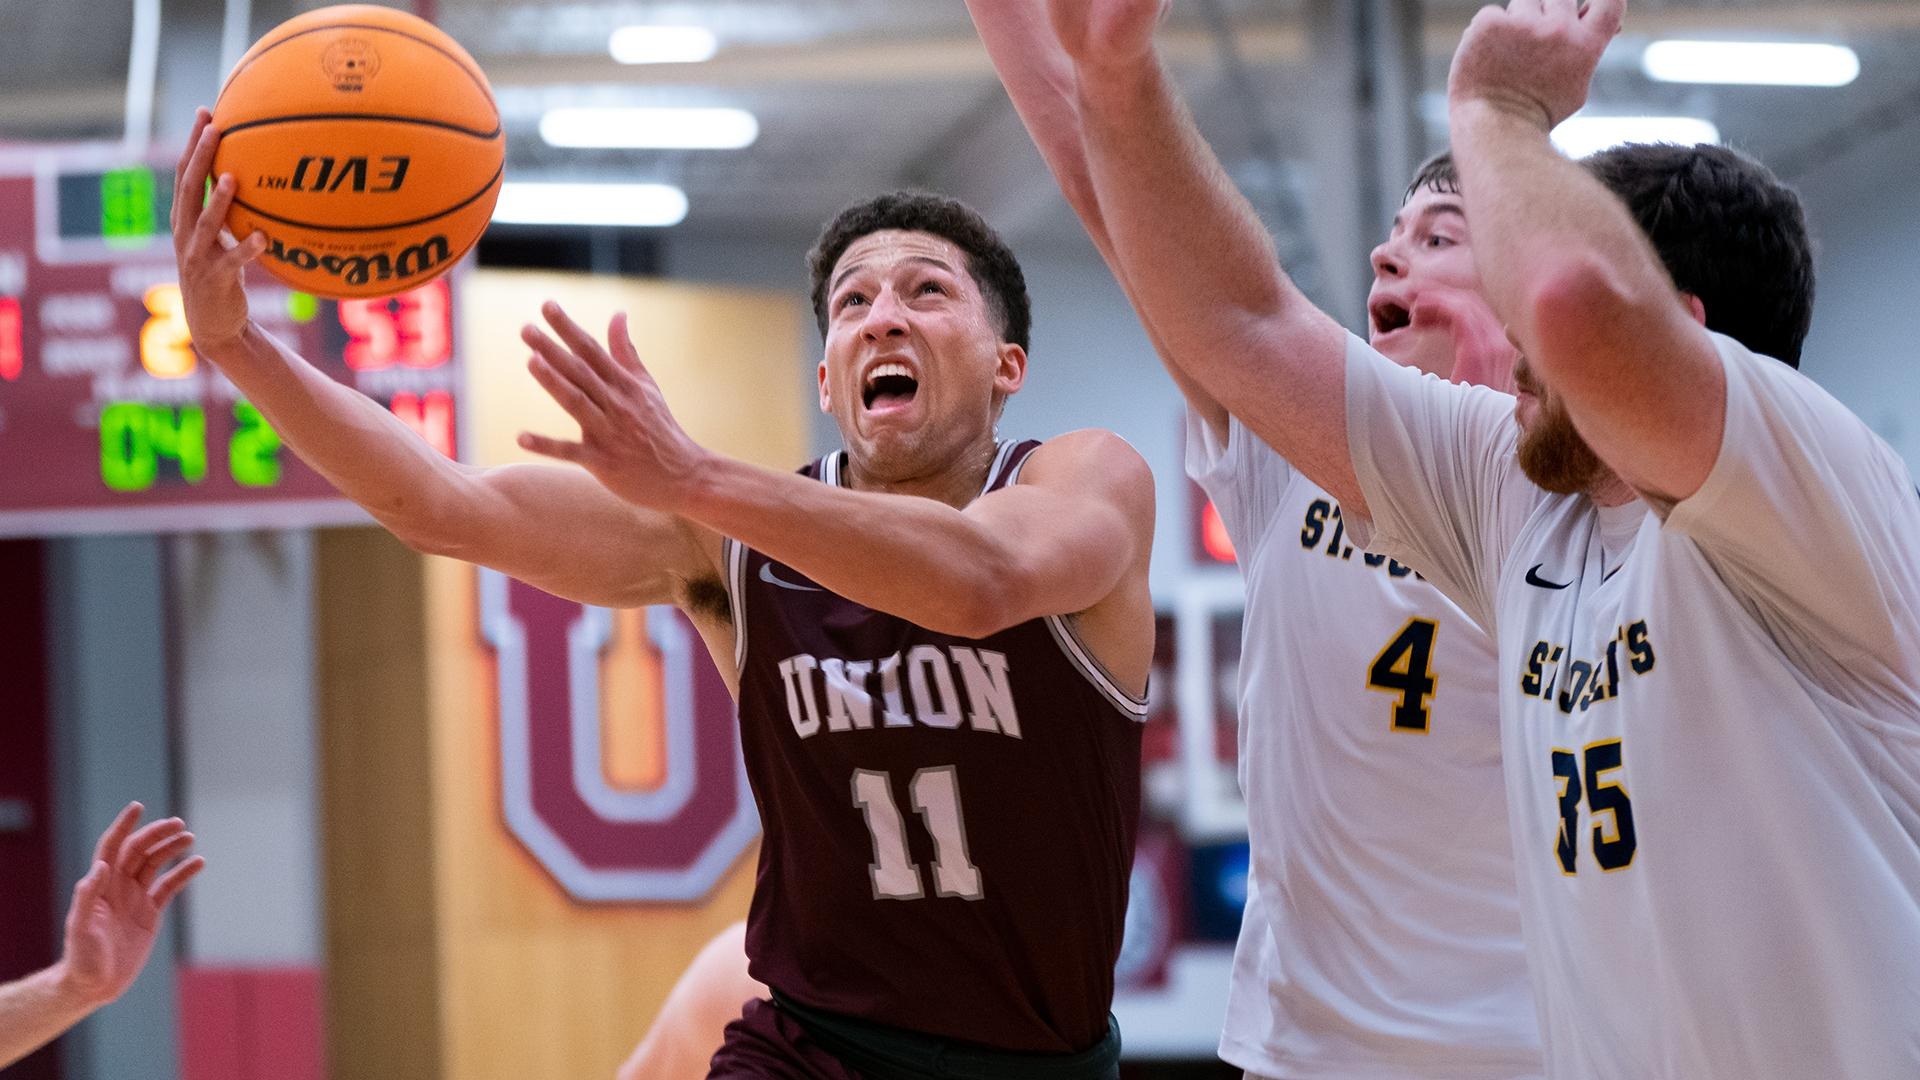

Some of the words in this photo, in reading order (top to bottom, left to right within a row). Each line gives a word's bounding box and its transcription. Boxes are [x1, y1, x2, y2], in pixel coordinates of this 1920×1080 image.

[291, 154, 411, 193] EVO
[779, 644, 1023, 740] UNION
[1366, 616, 1440, 736] 4
[850, 764, 985, 900] 11
[1551, 738, 1637, 877] 35
